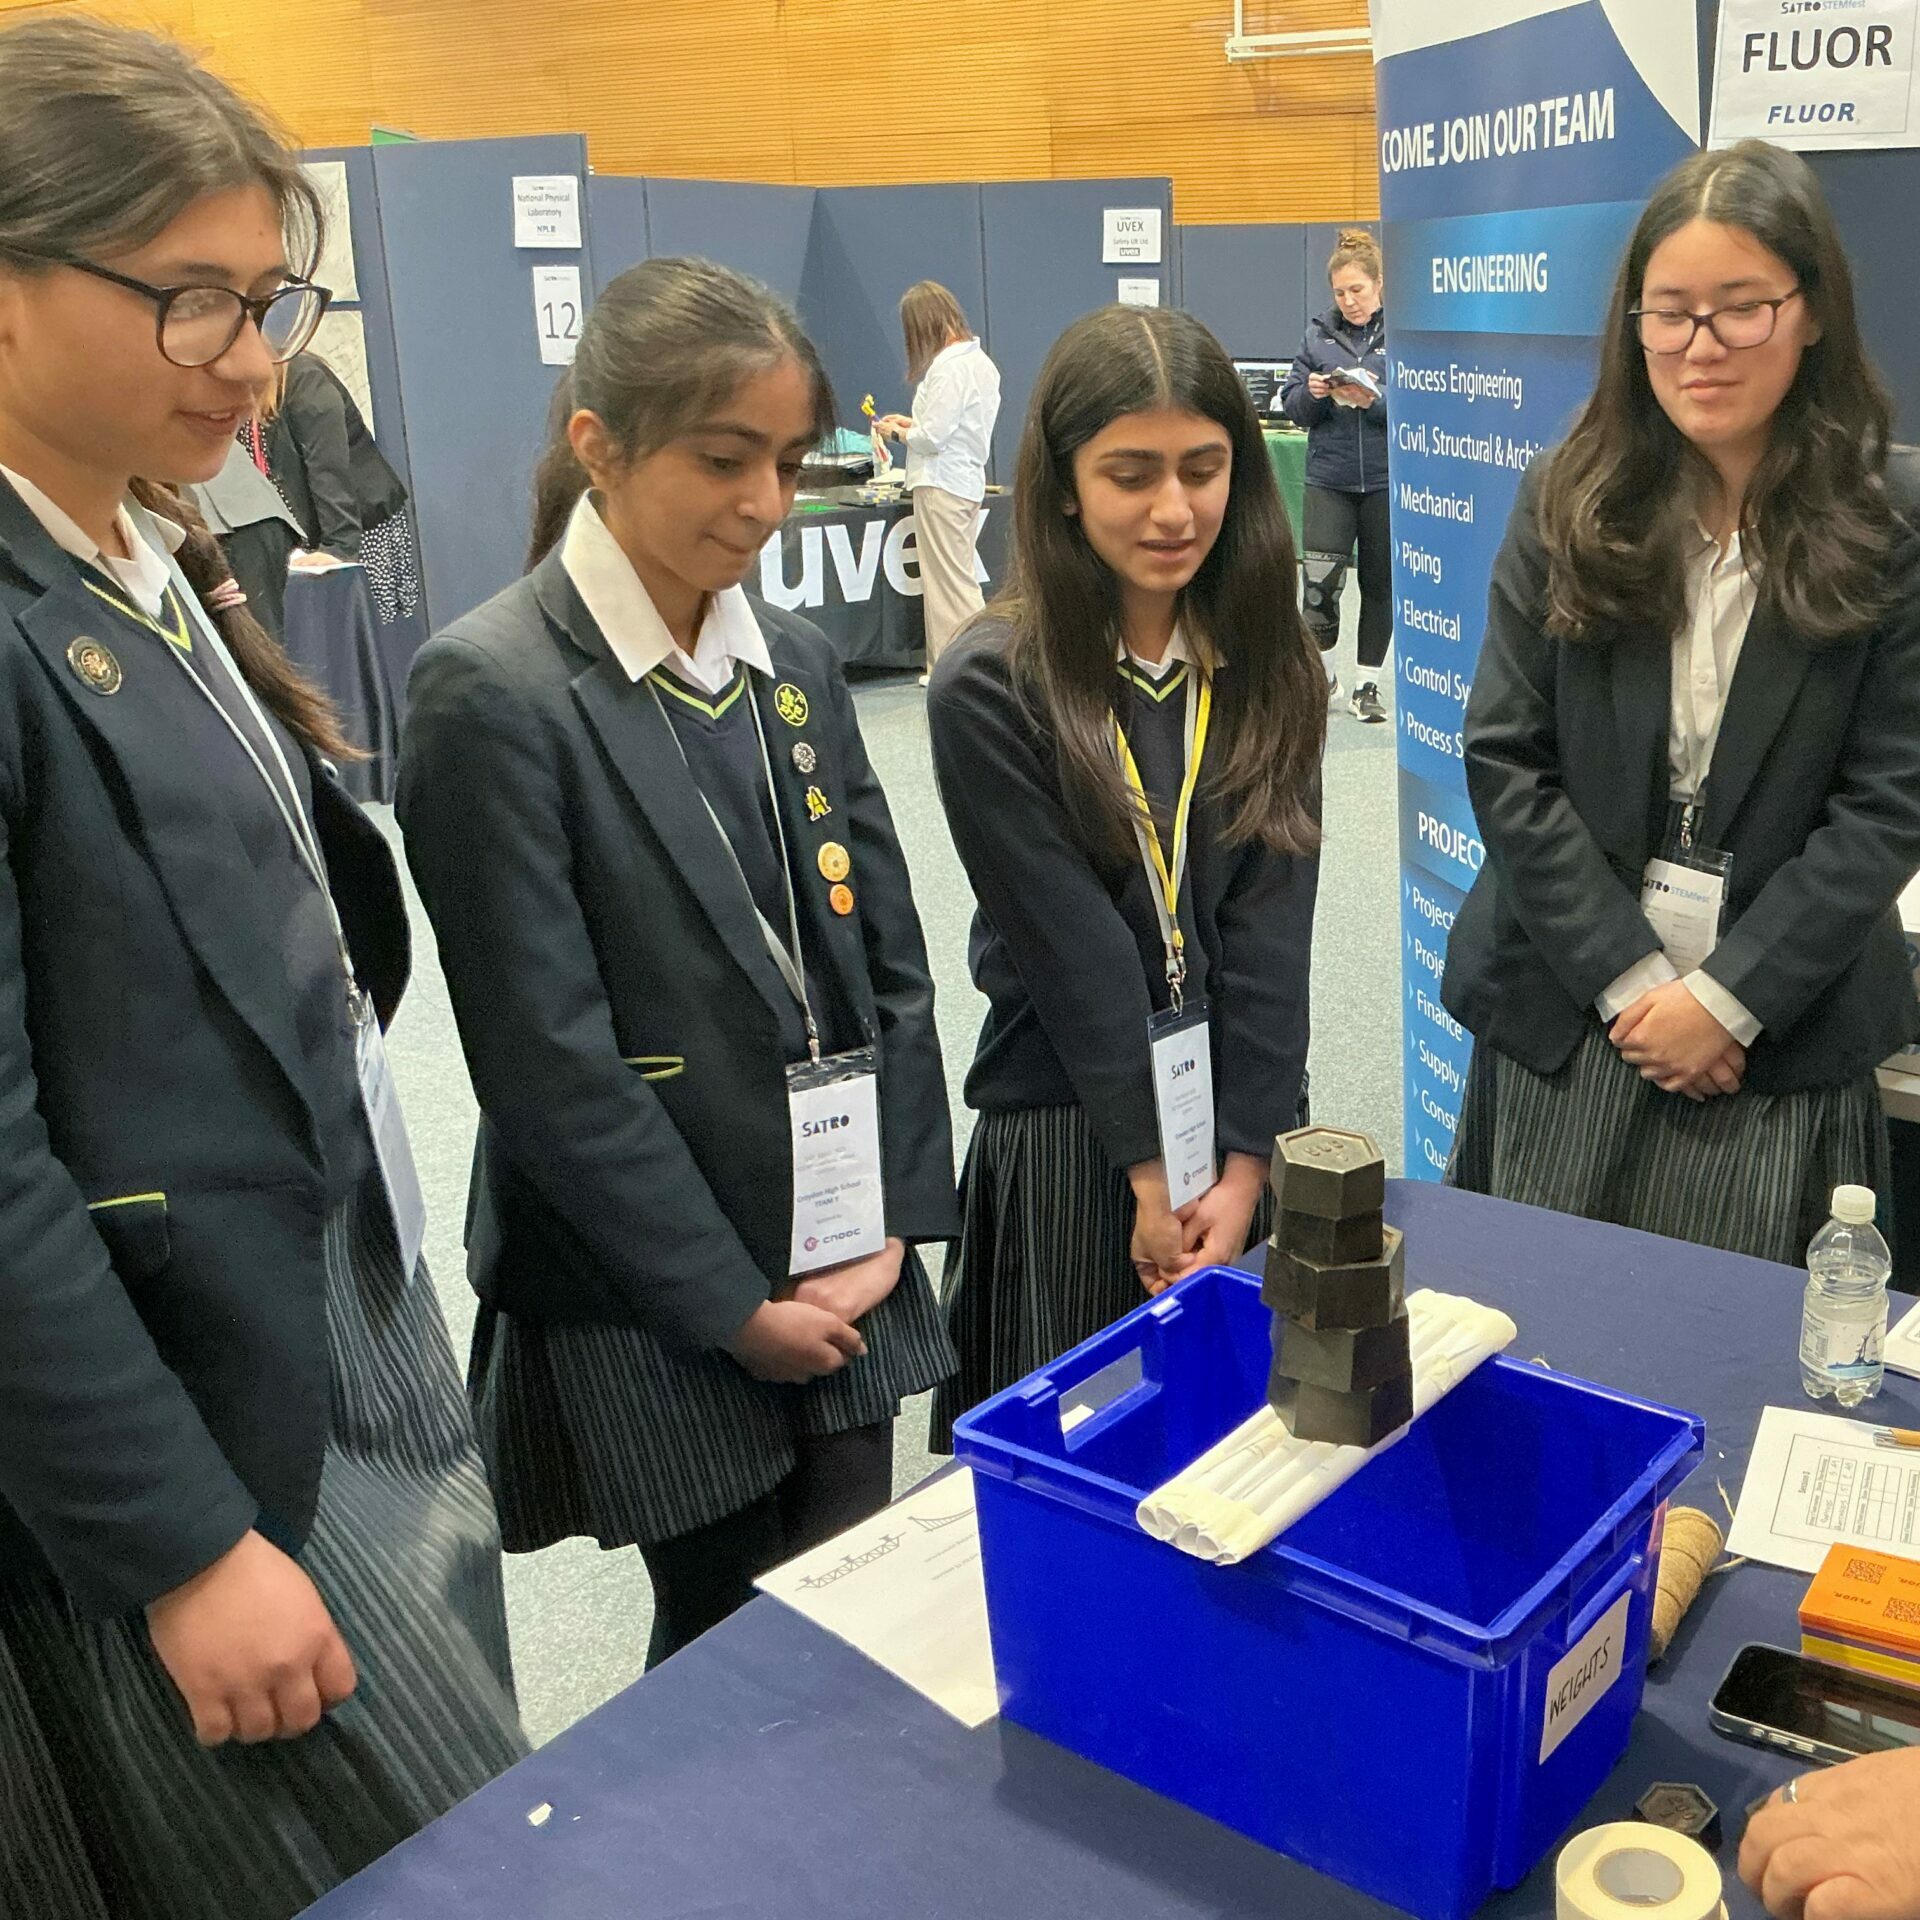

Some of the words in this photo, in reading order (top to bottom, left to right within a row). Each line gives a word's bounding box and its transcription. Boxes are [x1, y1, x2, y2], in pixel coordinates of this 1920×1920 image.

[1743, 25, 1892, 73] FLUOR
[1382, 123, 1435, 173] COME
[1439, 113, 1489, 166] JOIN
[1494, 103, 1538, 156] OUR
[1541, 88, 1614, 148] TEAM
[1767, 103, 1855, 124] FLUOR
[518, 193, 543, 202] National
[545, 193, 569, 203] Physical
[528, 208, 561, 218] Laboratory
[1117, 221, 1144, 232] UVEX
[1432, 252, 1548, 294] ENGINEERING
[543, 302, 579, 339] 12
[1397, 361, 1446, 392] Process
[1450, 364, 1522, 409] Engineering
[1399, 423, 1429, 458] Civil,
[1432, 426, 1493, 464] Structural
[1495, 436, 1504, 466] &
[1506, 438, 1543, 471] Arch
[1401, 483, 1474, 524] Mechanical
[1402, 541, 1441, 584] Piping
[1404, 599, 1461, 642] Electrical
[1405, 657, 1451, 697] Control
[1454, 674, 1472, 710] Sy
[1407, 711, 1452, 754] Process
[1417, 989, 1463, 1042] Finance
[1171, 1058, 1196, 1080] SATRO
[1419, 1039, 1460, 1093] Supply
[802, 1114, 850, 1138] SATRO
[1422, 1089, 1459, 1135] Const
[823, 1227, 862, 1244] cnooc
[1549, 1636, 1611, 1724] WEIGHTS
